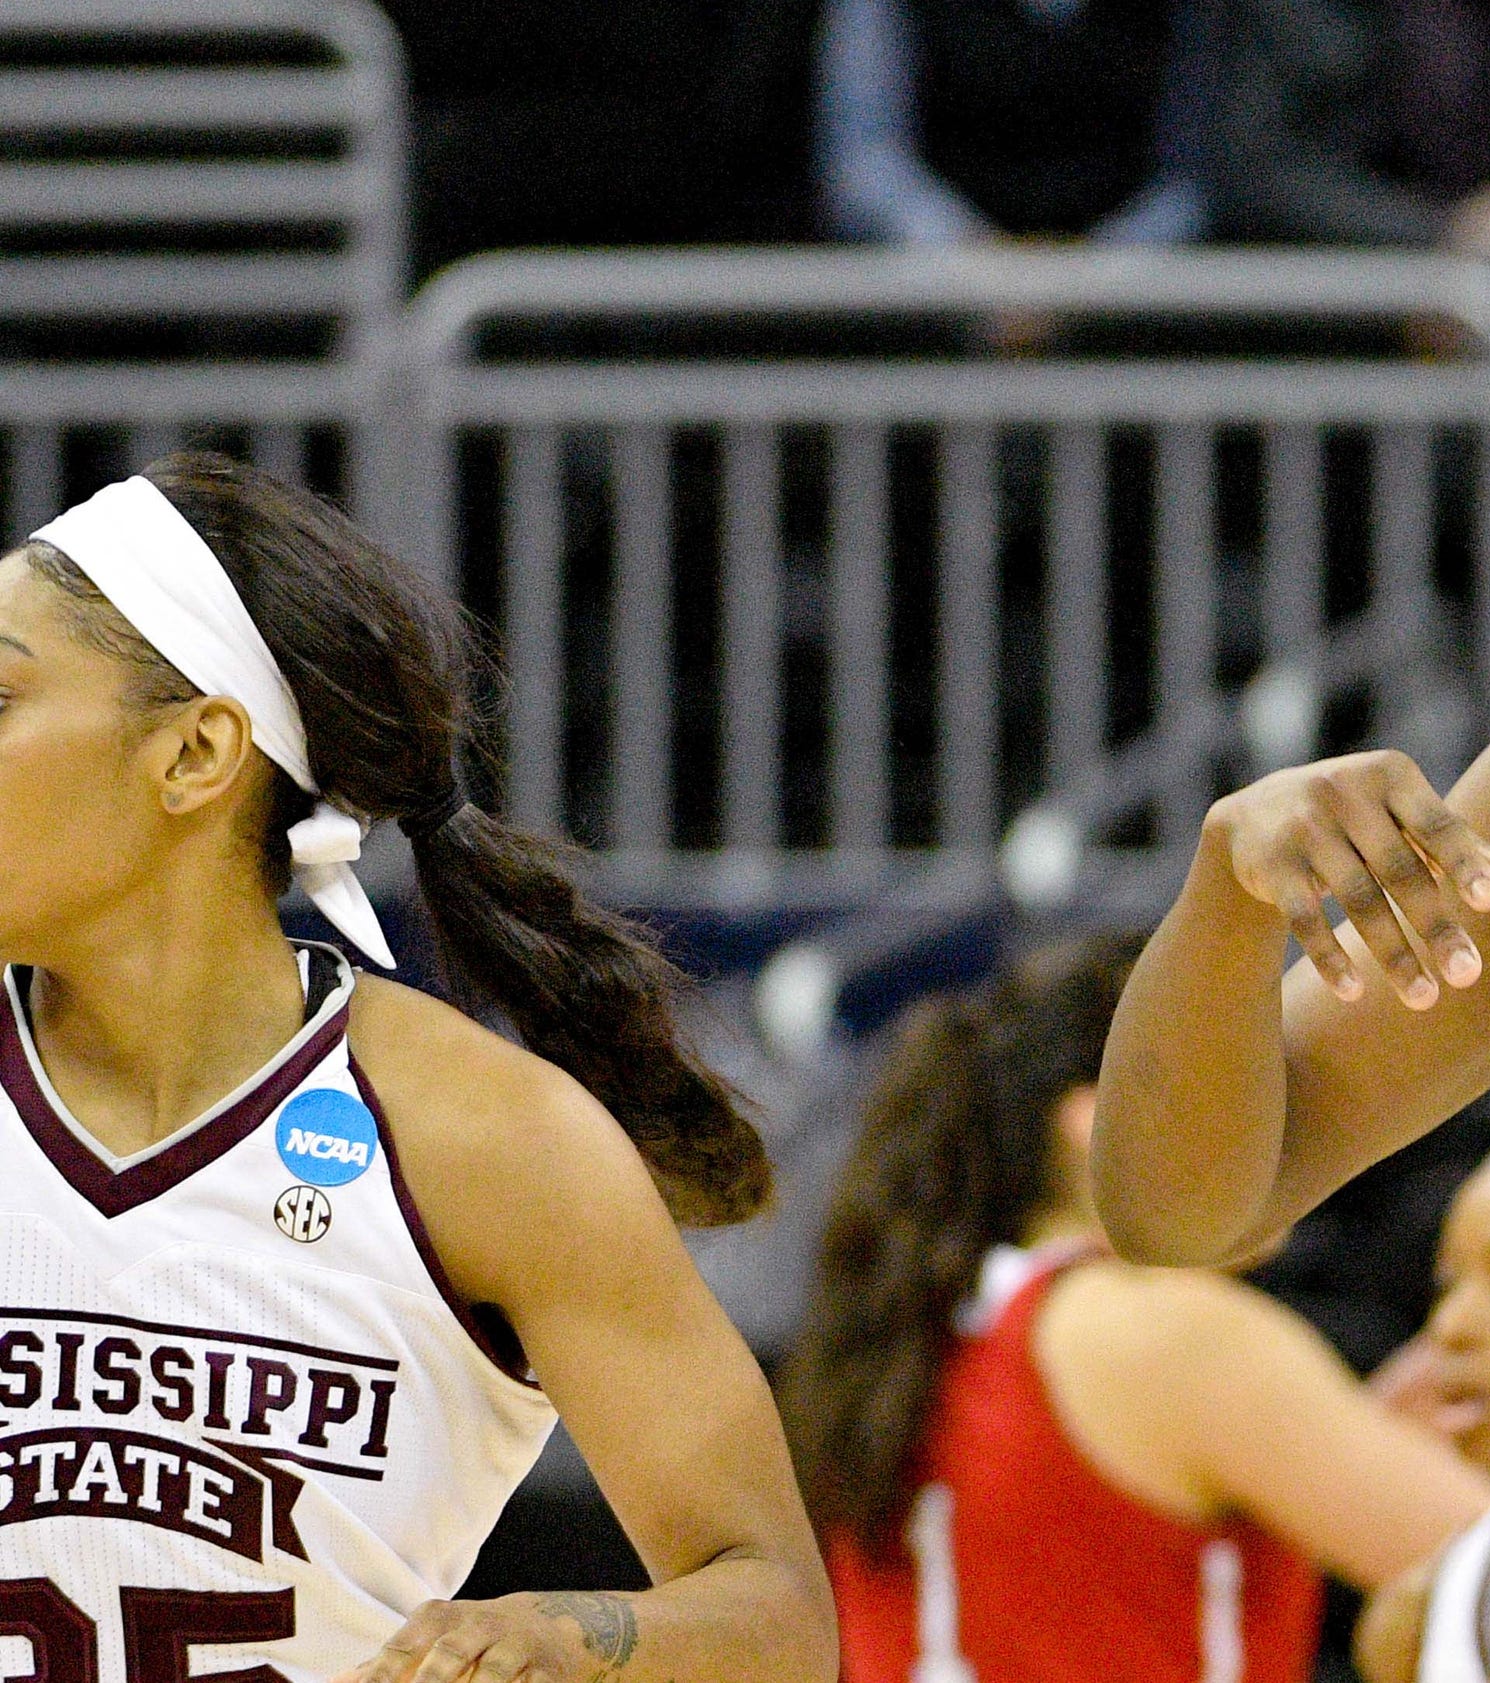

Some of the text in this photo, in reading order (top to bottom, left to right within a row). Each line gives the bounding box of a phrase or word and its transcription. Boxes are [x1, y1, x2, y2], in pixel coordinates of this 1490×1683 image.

[285, 1128, 369, 1168] NCAA
[275, 1186, 332, 1243] SEC
[0, 1330, 397, 1459] SISSIPPI
